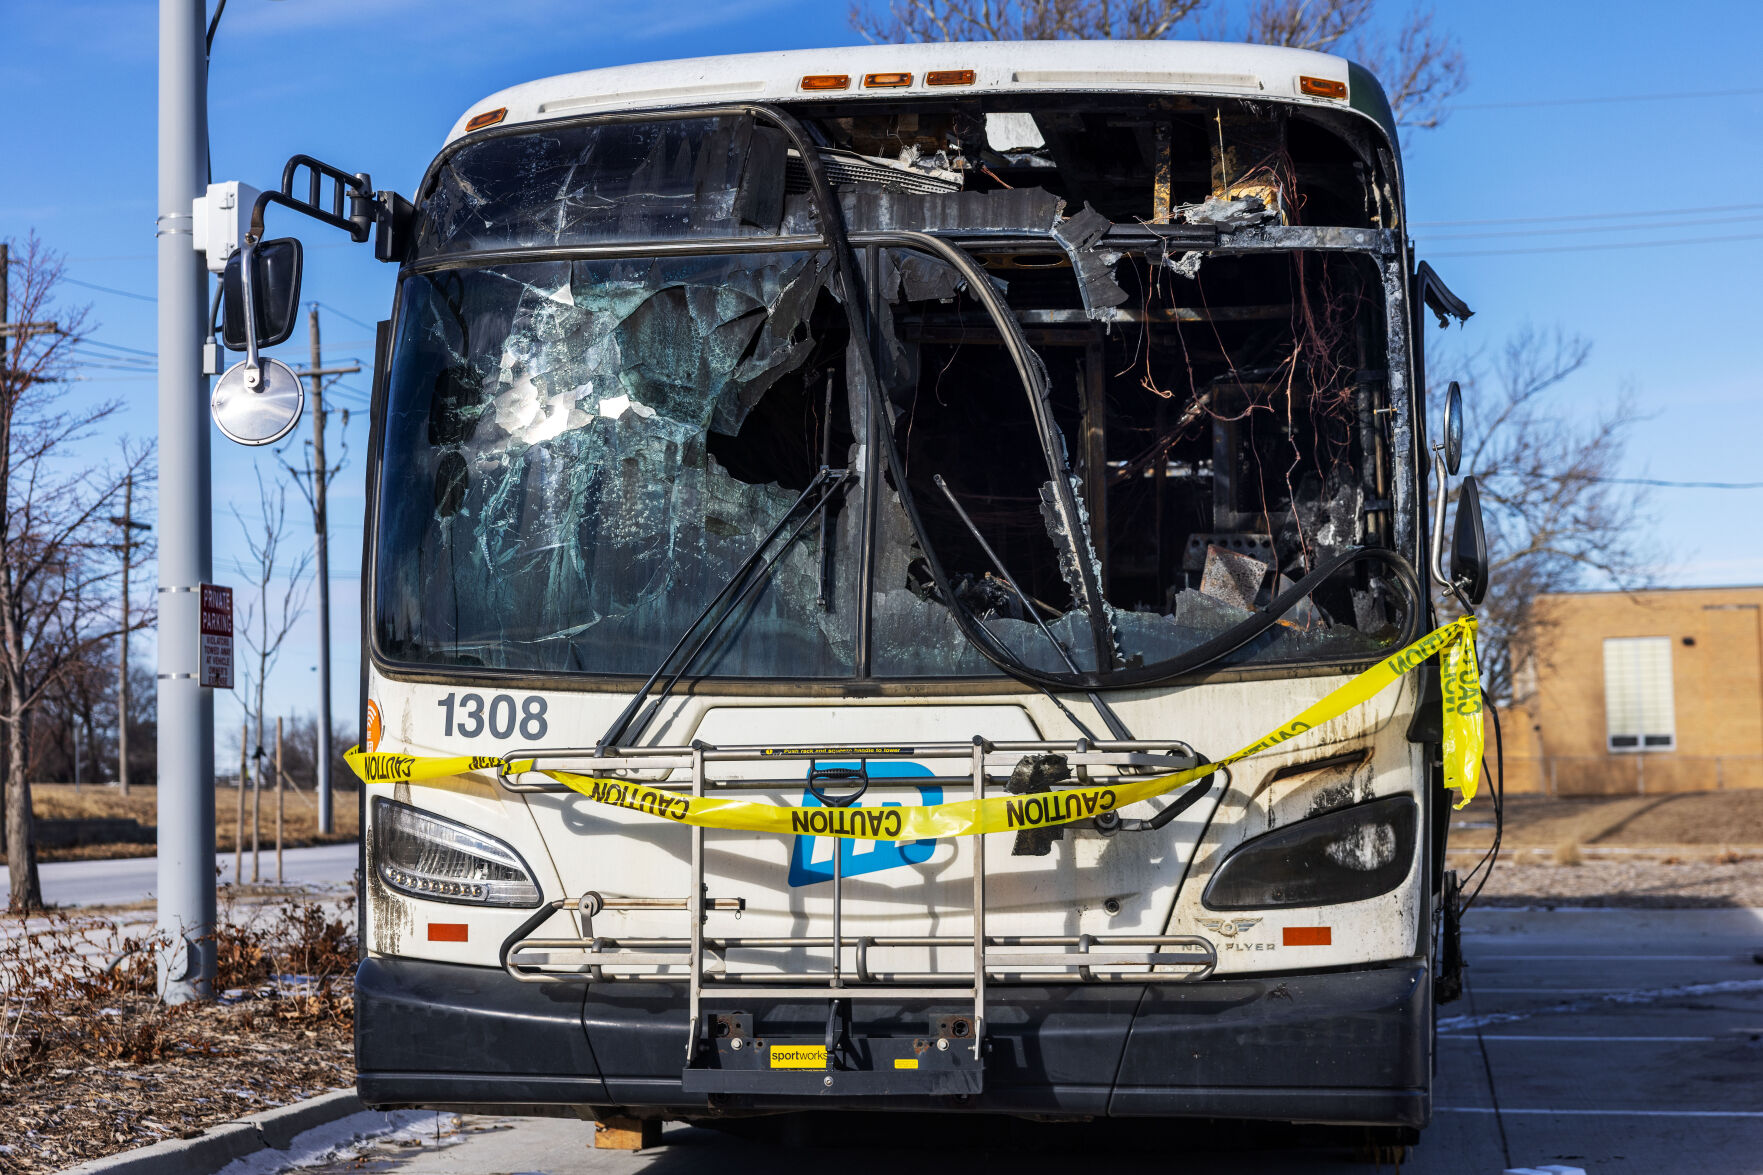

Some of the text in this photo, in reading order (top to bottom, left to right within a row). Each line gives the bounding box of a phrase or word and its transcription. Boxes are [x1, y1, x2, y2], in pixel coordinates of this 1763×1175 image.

[203, 589, 230, 610] PRIVATE
[203, 612, 231, 632] PARKING
[438, 692, 548, 740] 1308
[365, 755, 416, 781] CAUTION
[589, 781, 690, 820] CAUTION
[1006, 789, 1117, 828] CAUTION
[791, 809, 902, 837] CAUTION
[1226, 943, 1276, 952] FLYER
[771, 1050, 829, 1062] sportworks
